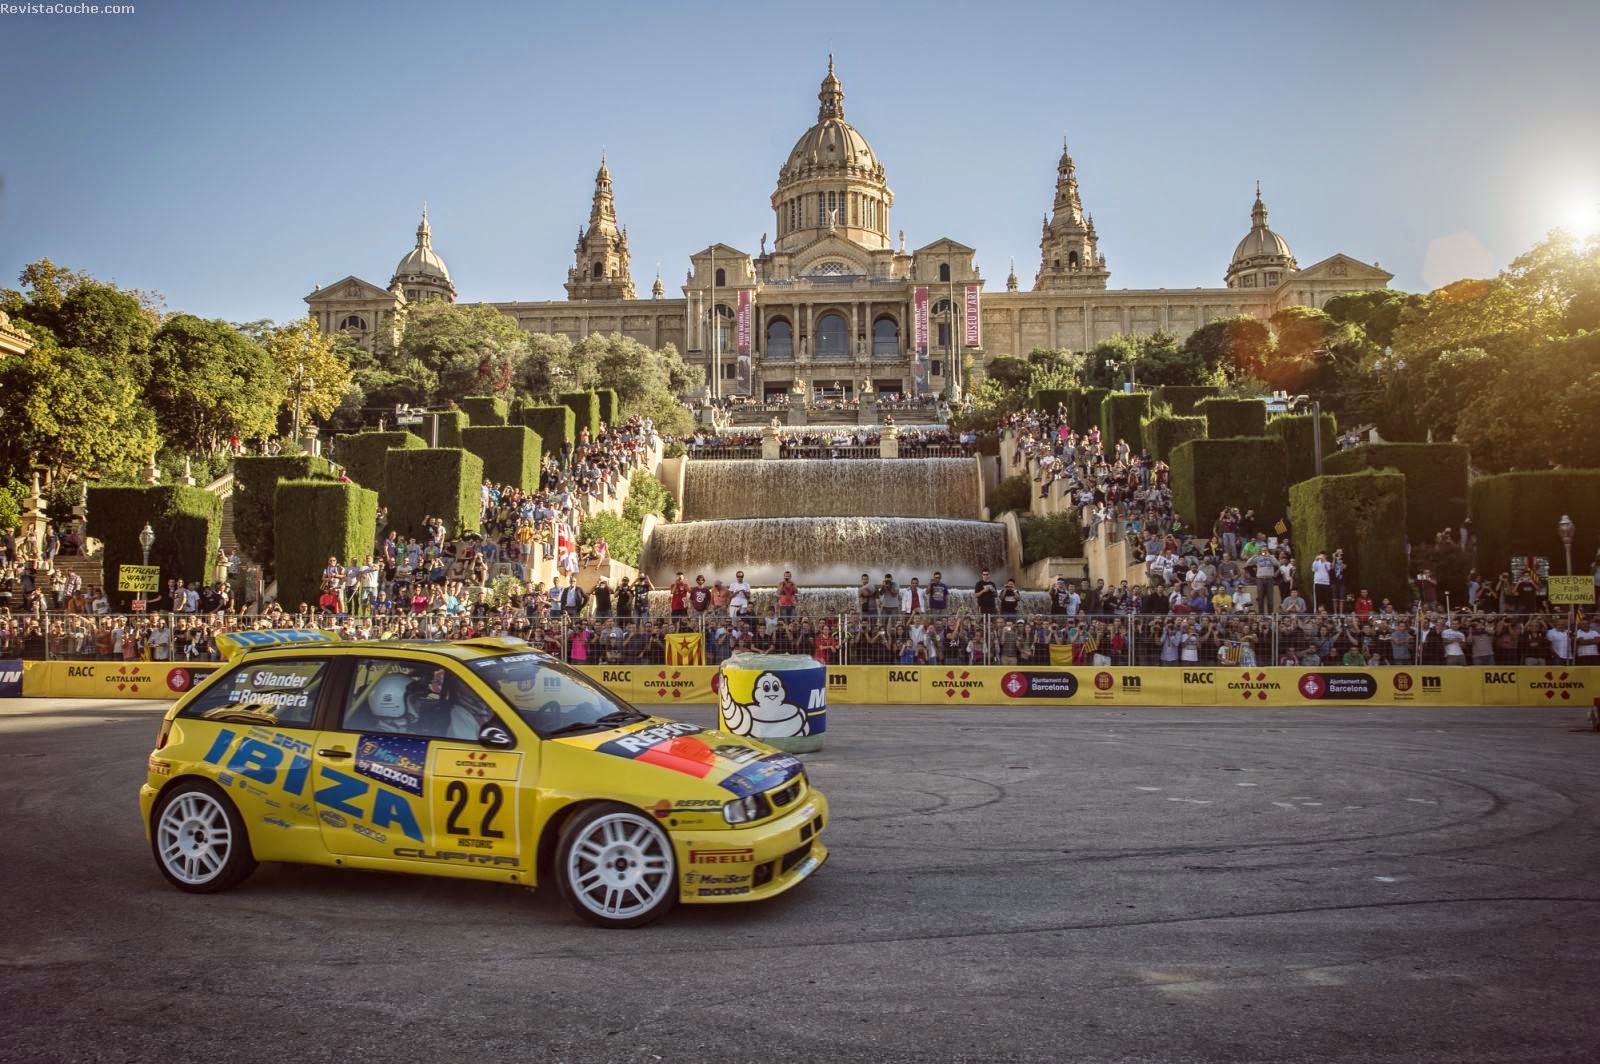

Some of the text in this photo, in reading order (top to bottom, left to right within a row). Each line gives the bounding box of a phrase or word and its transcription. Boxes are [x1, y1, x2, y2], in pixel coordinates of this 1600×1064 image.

[967, 290, 977, 342] MUSEU D'ART
[126, 574, 154, 582] WANT
[226, 629, 333, 646] IBIZA
[68, 666, 95, 677] RACC
[603, 671, 631, 682] RACC
[889, 671, 918, 682] RACC
[253, 671, 308, 687] Silander
[1184, 672, 1214, 684] RACC
[1485, 672, 1516, 684] RACC
[1031, 683, 1069, 691] Barcelona
[1228, 682, 1280, 690] CATALUNYA
[1329, 684, 1368, 692] Barcelona
[239, 689, 309, 709] Rovanperä
[272, 733, 313, 754] SEAT
[456, 760, 497, 768] CATALUNYA
[370, 763, 420, 788] maxon
[203, 728, 425, 843] IBIZA
[674, 799, 721, 807] REPSOL
[446, 780, 504, 839] 22
[457, 838, 494, 849] HISTORIC
[393, 848, 519, 867] CUPRA
[689, 848, 754, 865] PIRELLI
